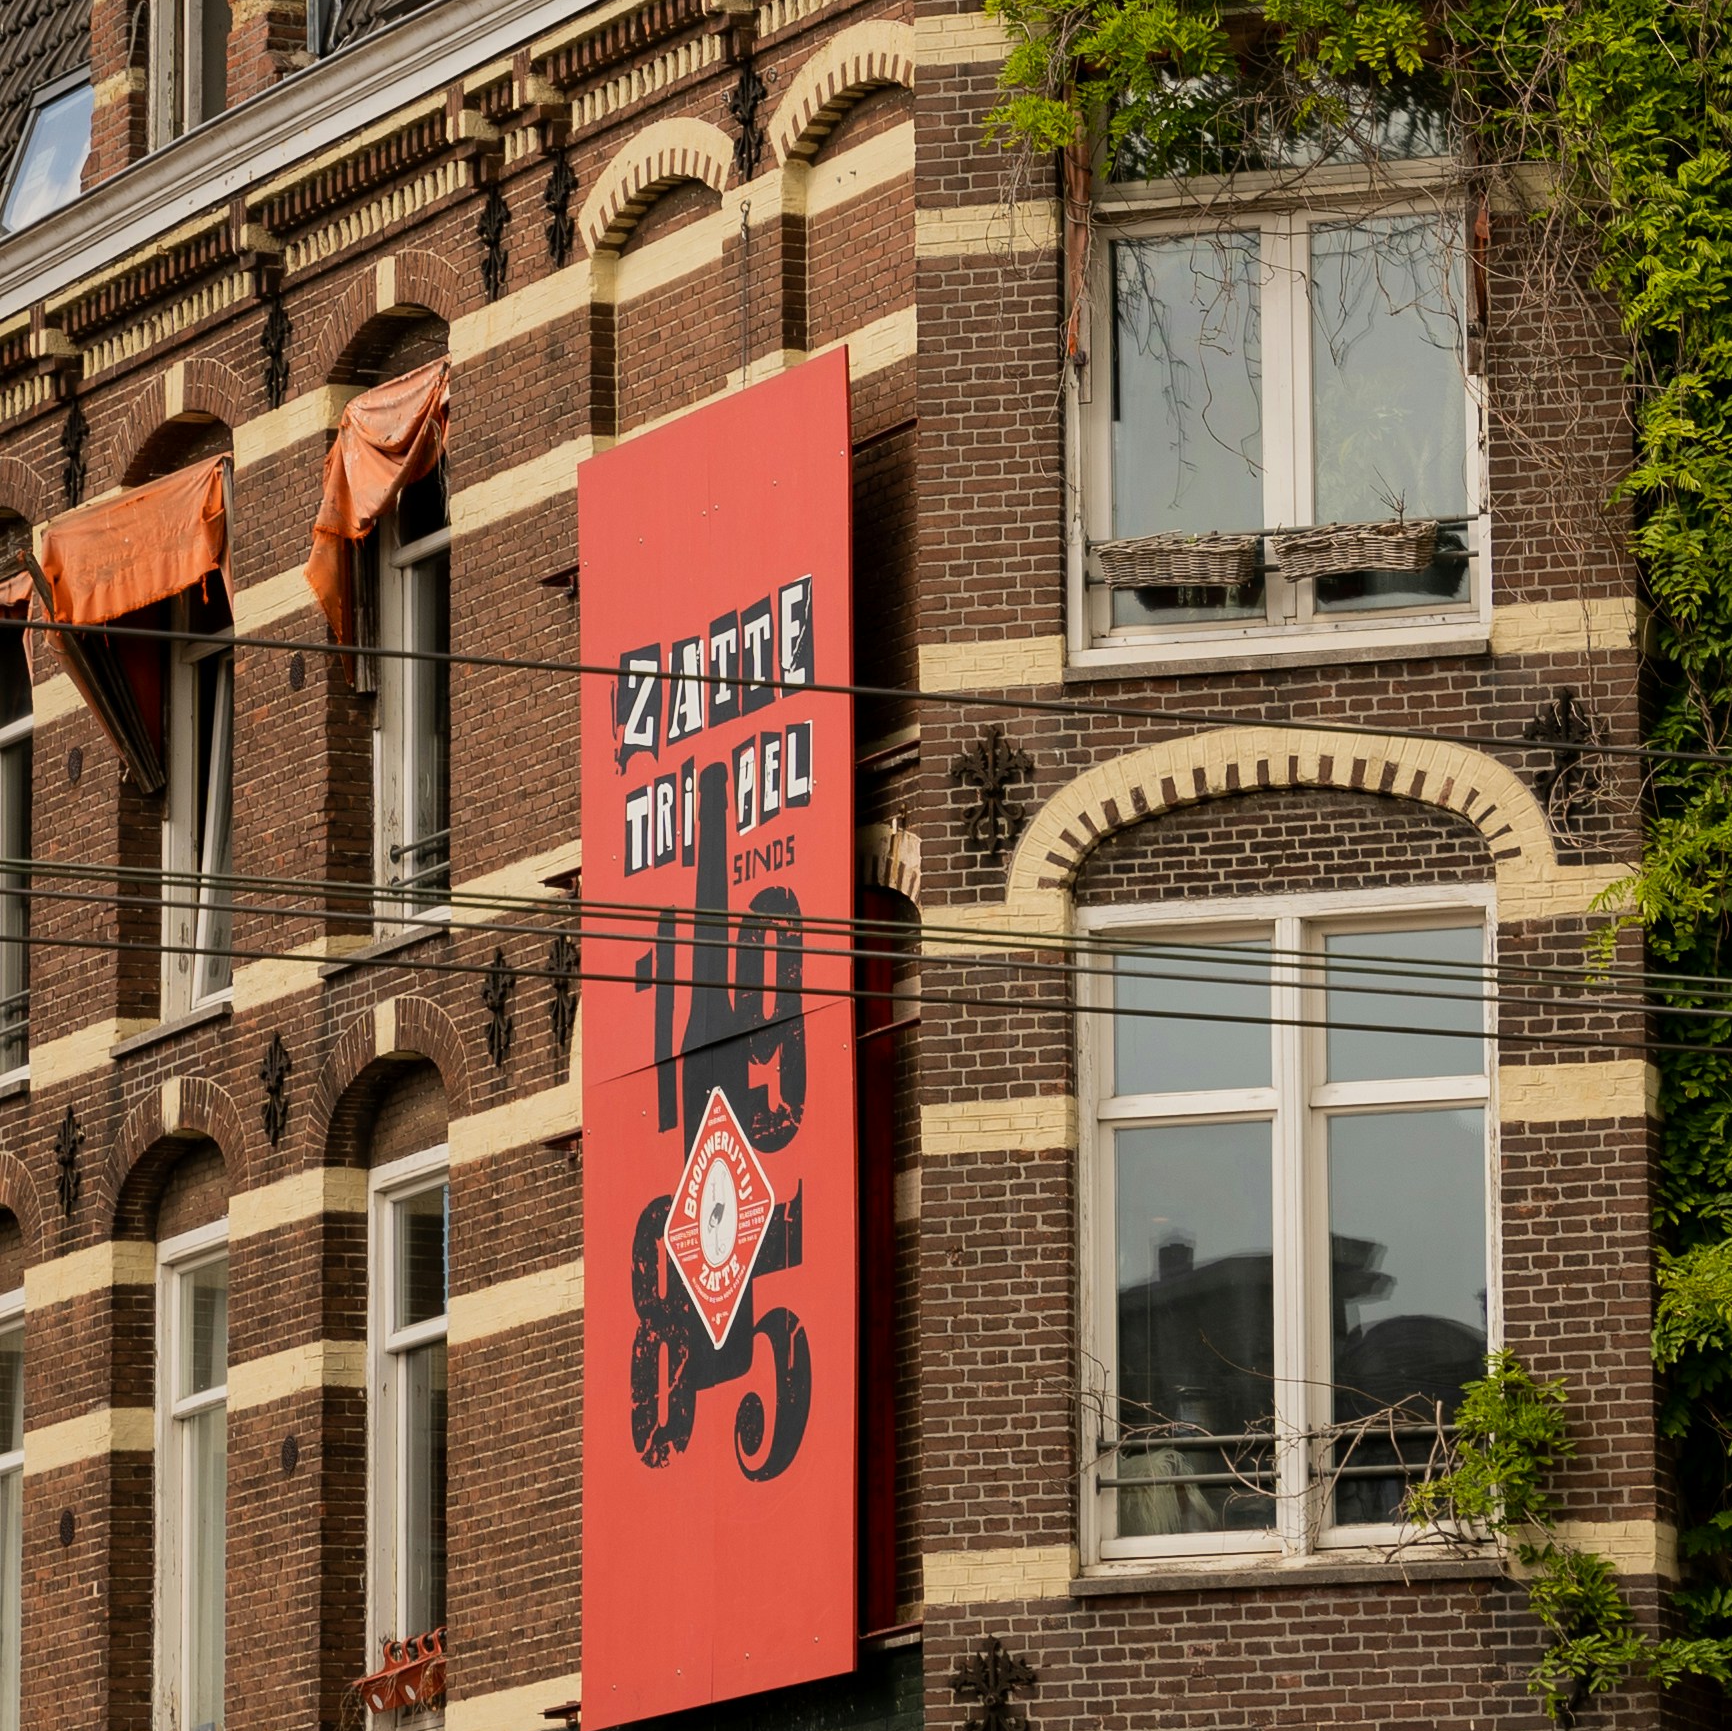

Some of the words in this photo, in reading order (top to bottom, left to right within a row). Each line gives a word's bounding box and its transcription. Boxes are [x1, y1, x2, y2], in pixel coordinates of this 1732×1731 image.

[622, 578, 814, 748] ZATTE
[733, 835, 795, 885] SINDS
[684, 1131, 740, 1220] BROUWERIJ
[676, 1238, 699, 1250] TRIPEL
[699, 1253, 740, 1293] ZATTE
